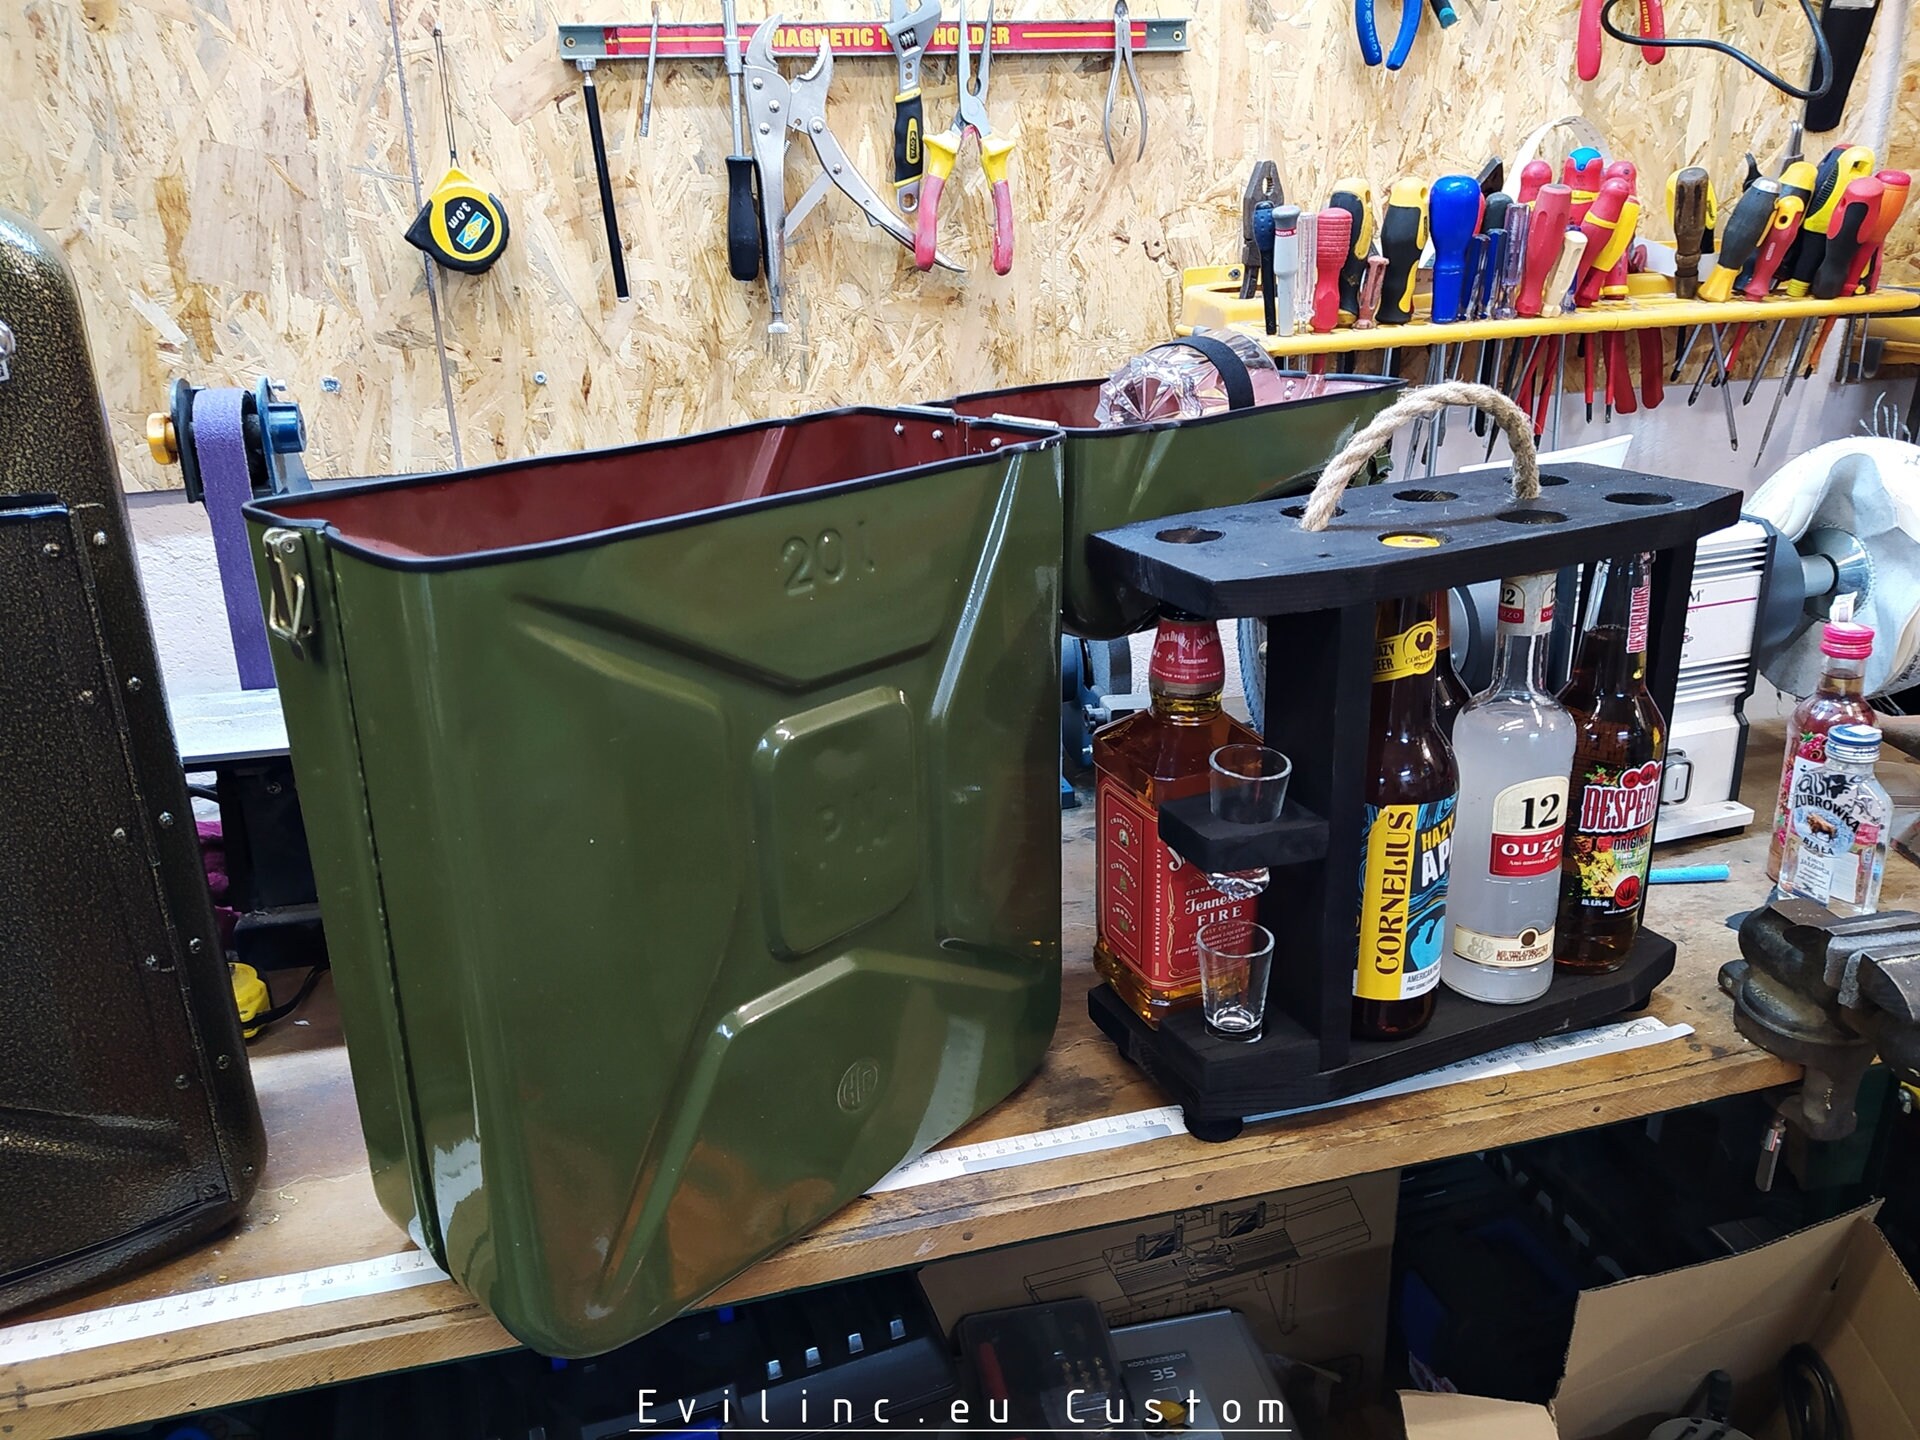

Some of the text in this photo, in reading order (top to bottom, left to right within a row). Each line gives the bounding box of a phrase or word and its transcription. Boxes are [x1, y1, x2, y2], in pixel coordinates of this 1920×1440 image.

[772, 27, 874, 47] MAGNETIC
[933, 26, 1010, 46] HODER
[781, 526, 847, 597] 20
[1627, 586, 1650, 653] DESPERADOS
[1520, 793, 1560, 830] 12
[1421, 837, 1453, 887] AP
[1501, 834, 1563, 858] OUZO
[1375, 811, 1414, 975] CORNELIUS
[1197, 905, 1243, 927] FIRE
[1150, 1366, 1177, 1382] 35
